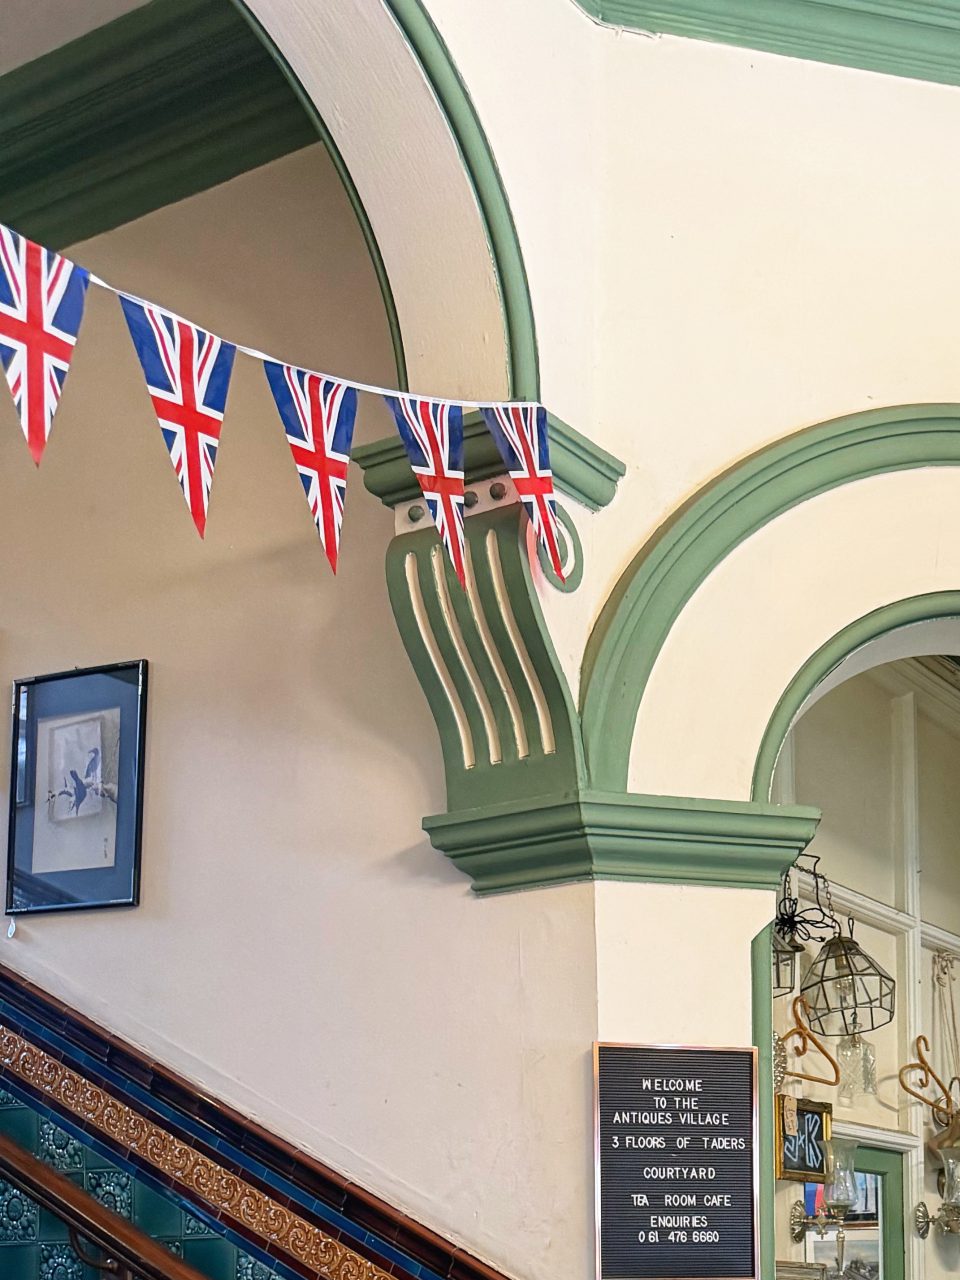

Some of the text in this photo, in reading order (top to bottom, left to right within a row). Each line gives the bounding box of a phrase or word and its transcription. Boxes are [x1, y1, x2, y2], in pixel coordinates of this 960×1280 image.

[643, 1078, 702, 1091] WELCOME
[654, 1097, 698, 1109] TO THE
[613, 1112, 729, 1125] ANTIQUES VILLAGE
[612, 1136, 745, 1149] 3 FLOORS OF TADERS
[644, 1167, 715, 1179] COURTYARD
[631, 1194, 731, 1206] TEA ROOM CAFE
[651, 1216, 707, 1227] ENQUIRIES
[668, 1231, 687, 1242] 476
[693, 1231, 719, 1242] 6660
